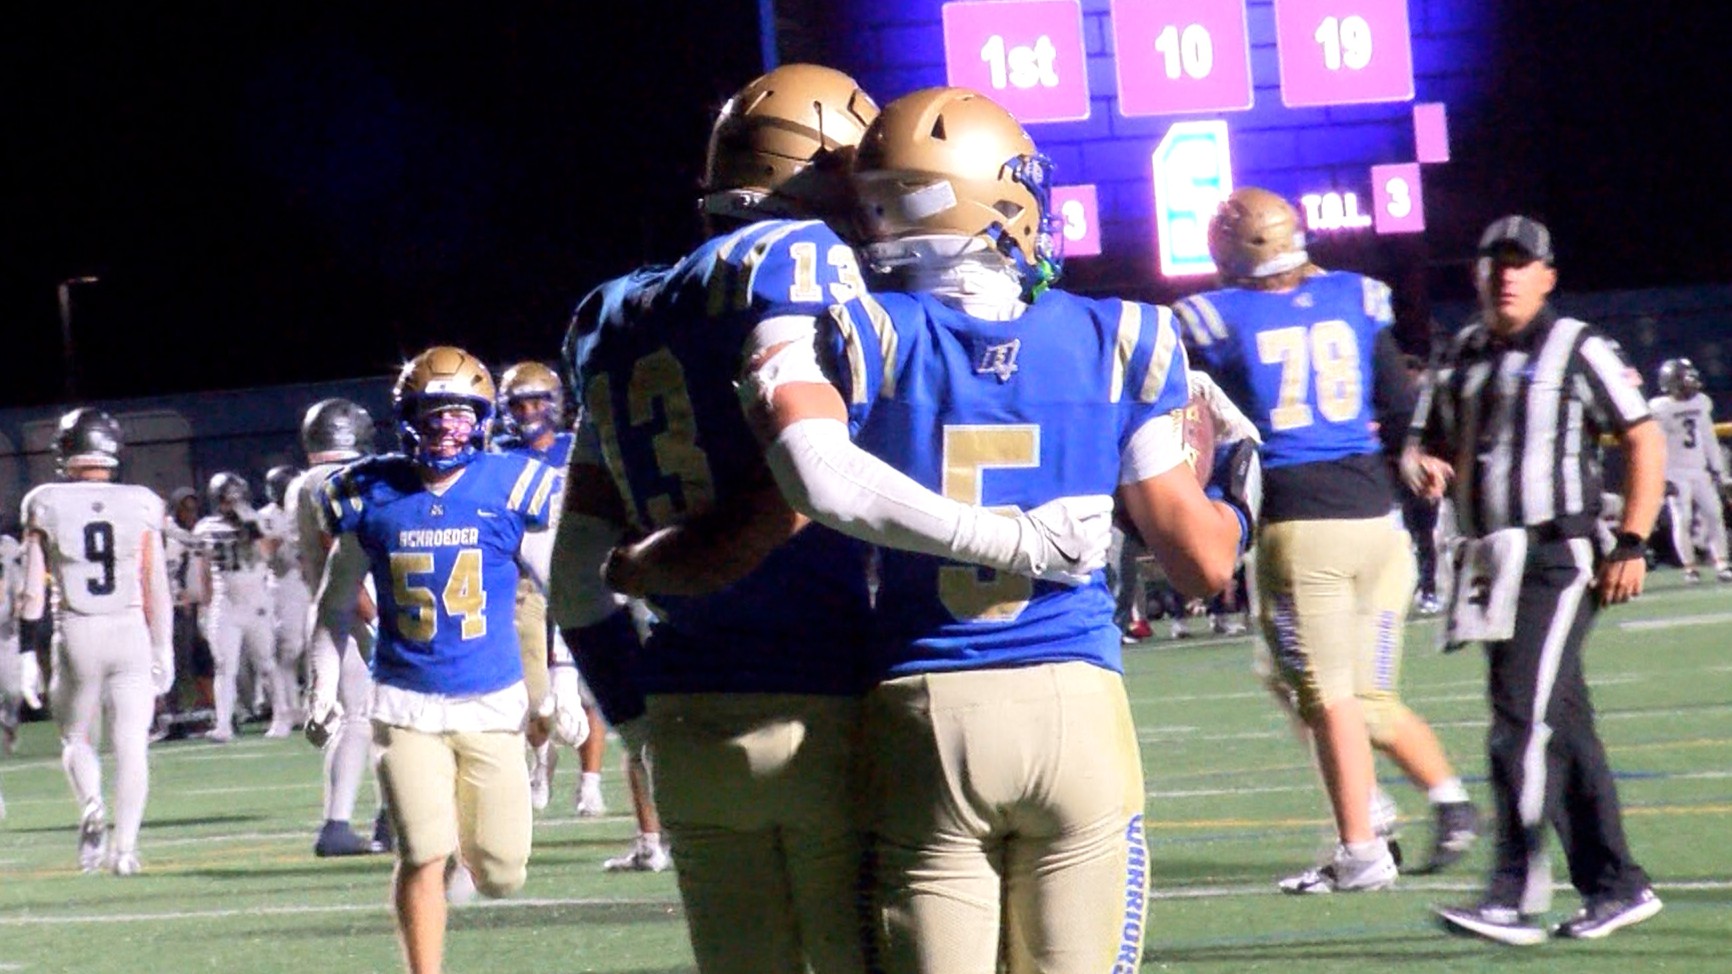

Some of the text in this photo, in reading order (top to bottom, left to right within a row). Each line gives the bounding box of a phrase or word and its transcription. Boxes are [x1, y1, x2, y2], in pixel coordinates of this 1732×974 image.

[981, 35, 1058, 89] 1st
[1155, 24, 1213, 78] 10
[1314, 16, 1372, 70] 19
[1062, 200, 1087, 240] 3
[1386, 178, 1412, 218] 3
[789, 242, 867, 303] 13
[1256, 319, 1363, 431] 78
[585, 345, 716, 533] 13
[939, 424, 1041, 623] 5
[83, 520, 116, 596] 9
[389, 549, 487, 642] 54
